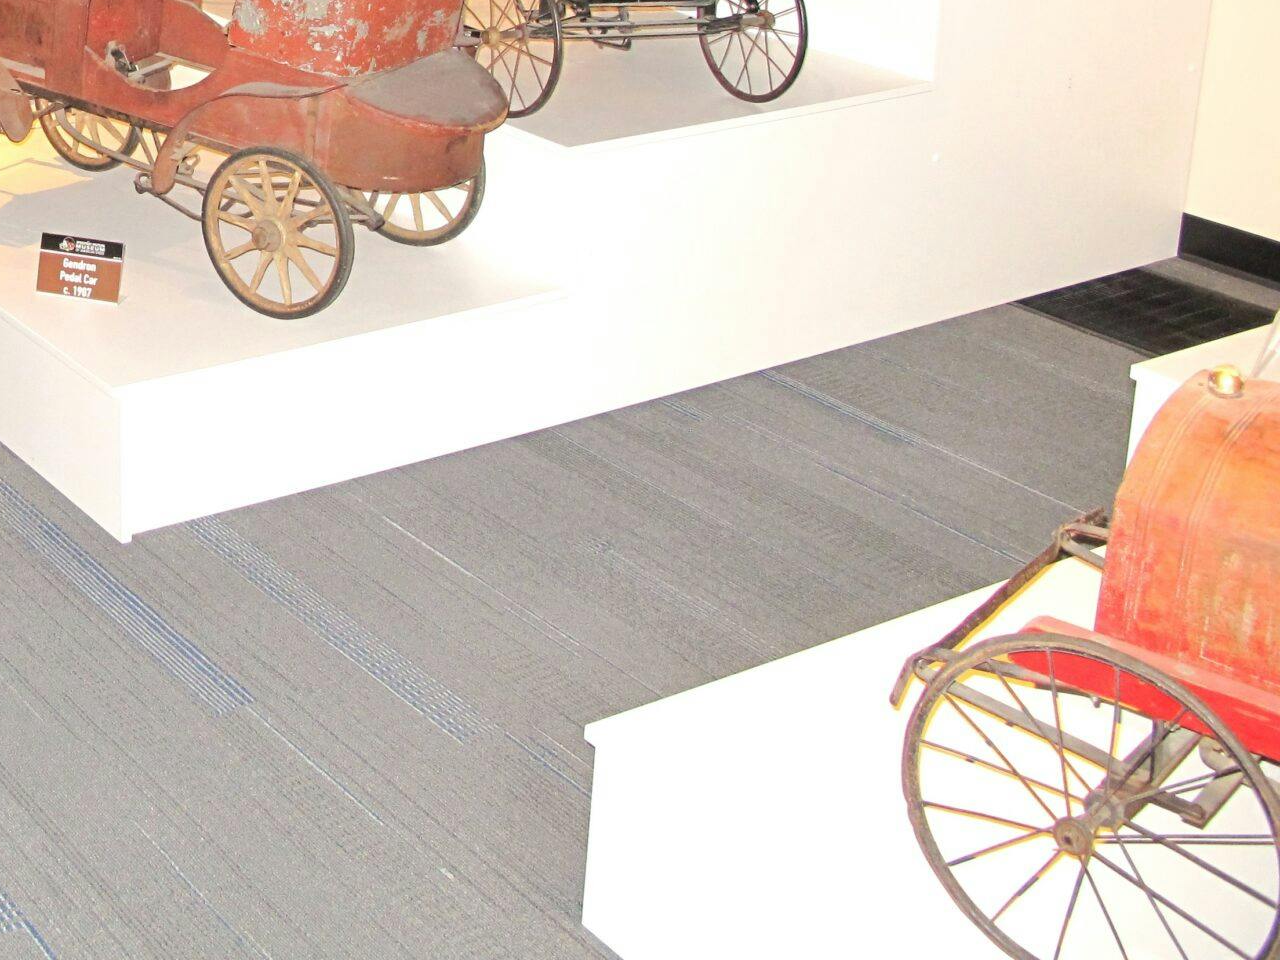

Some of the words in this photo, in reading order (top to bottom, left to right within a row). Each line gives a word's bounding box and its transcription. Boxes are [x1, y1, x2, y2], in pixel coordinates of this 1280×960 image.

[63, 258, 97, 272] Gendron
[60, 270, 82, 283] Pedal
[83, 274, 98, 286] Car
[73, 285, 92, 298] 1907
